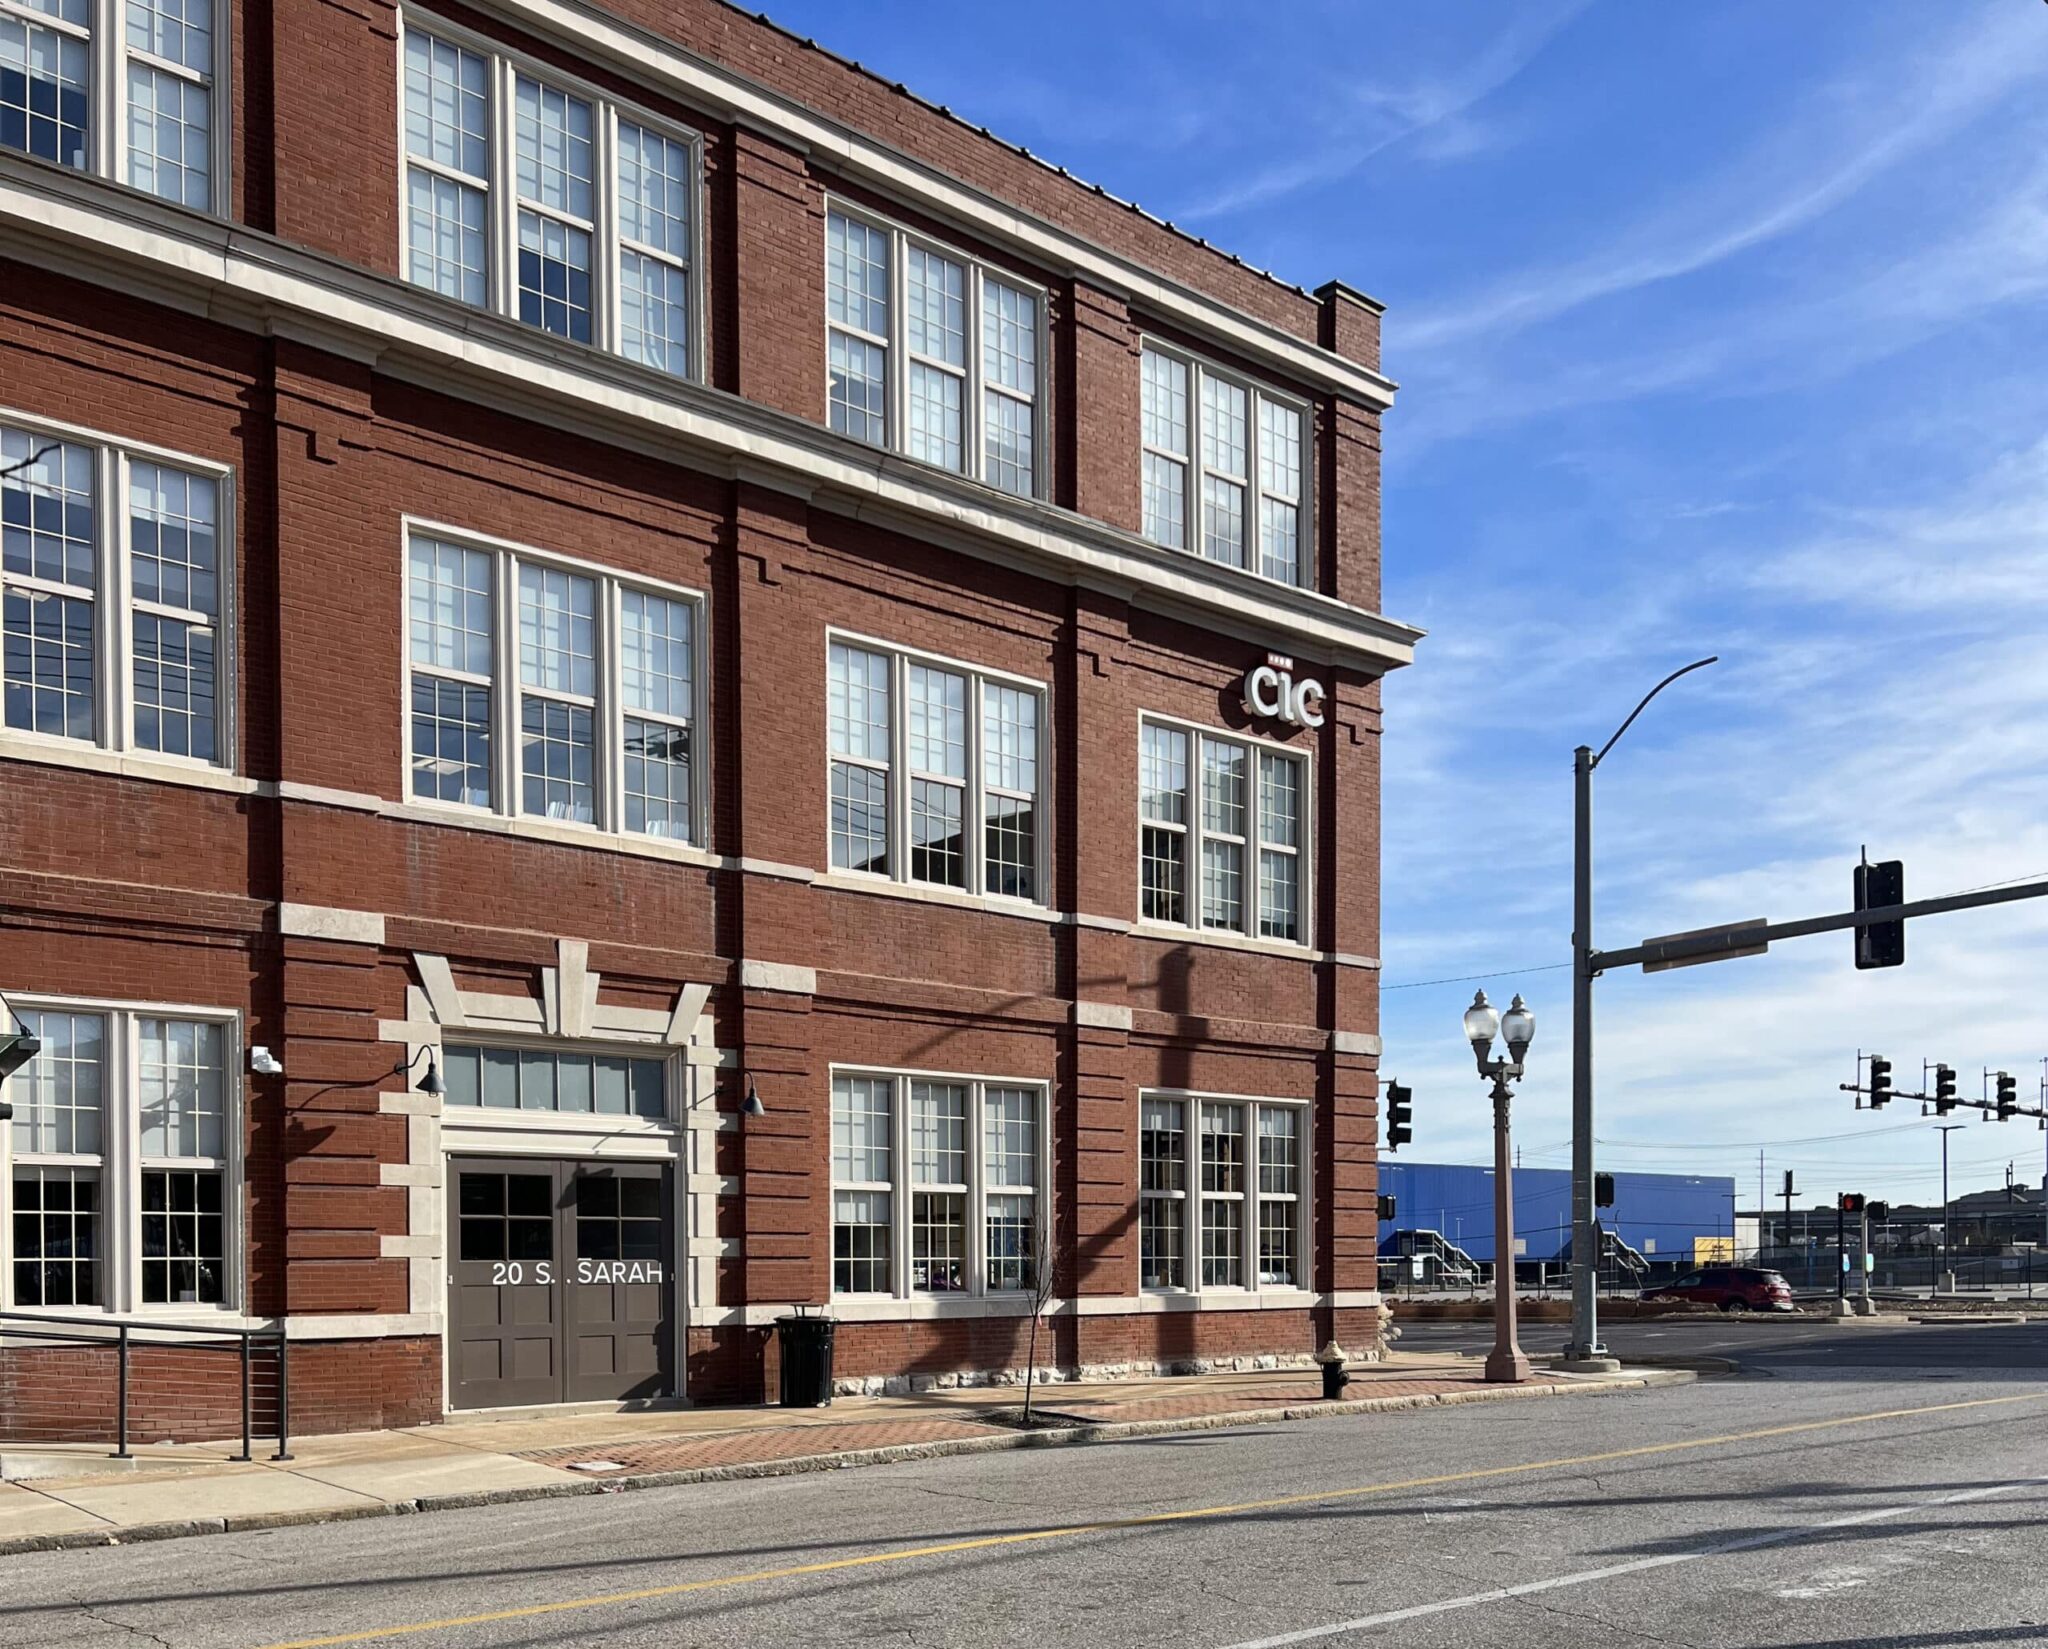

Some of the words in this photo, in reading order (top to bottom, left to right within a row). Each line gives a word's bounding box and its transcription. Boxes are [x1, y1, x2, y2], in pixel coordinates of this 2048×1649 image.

[493, 1262, 523, 1285] 20
[535, 1262, 556, 1285] S.
[577, 1261, 662, 1284] SARAH
